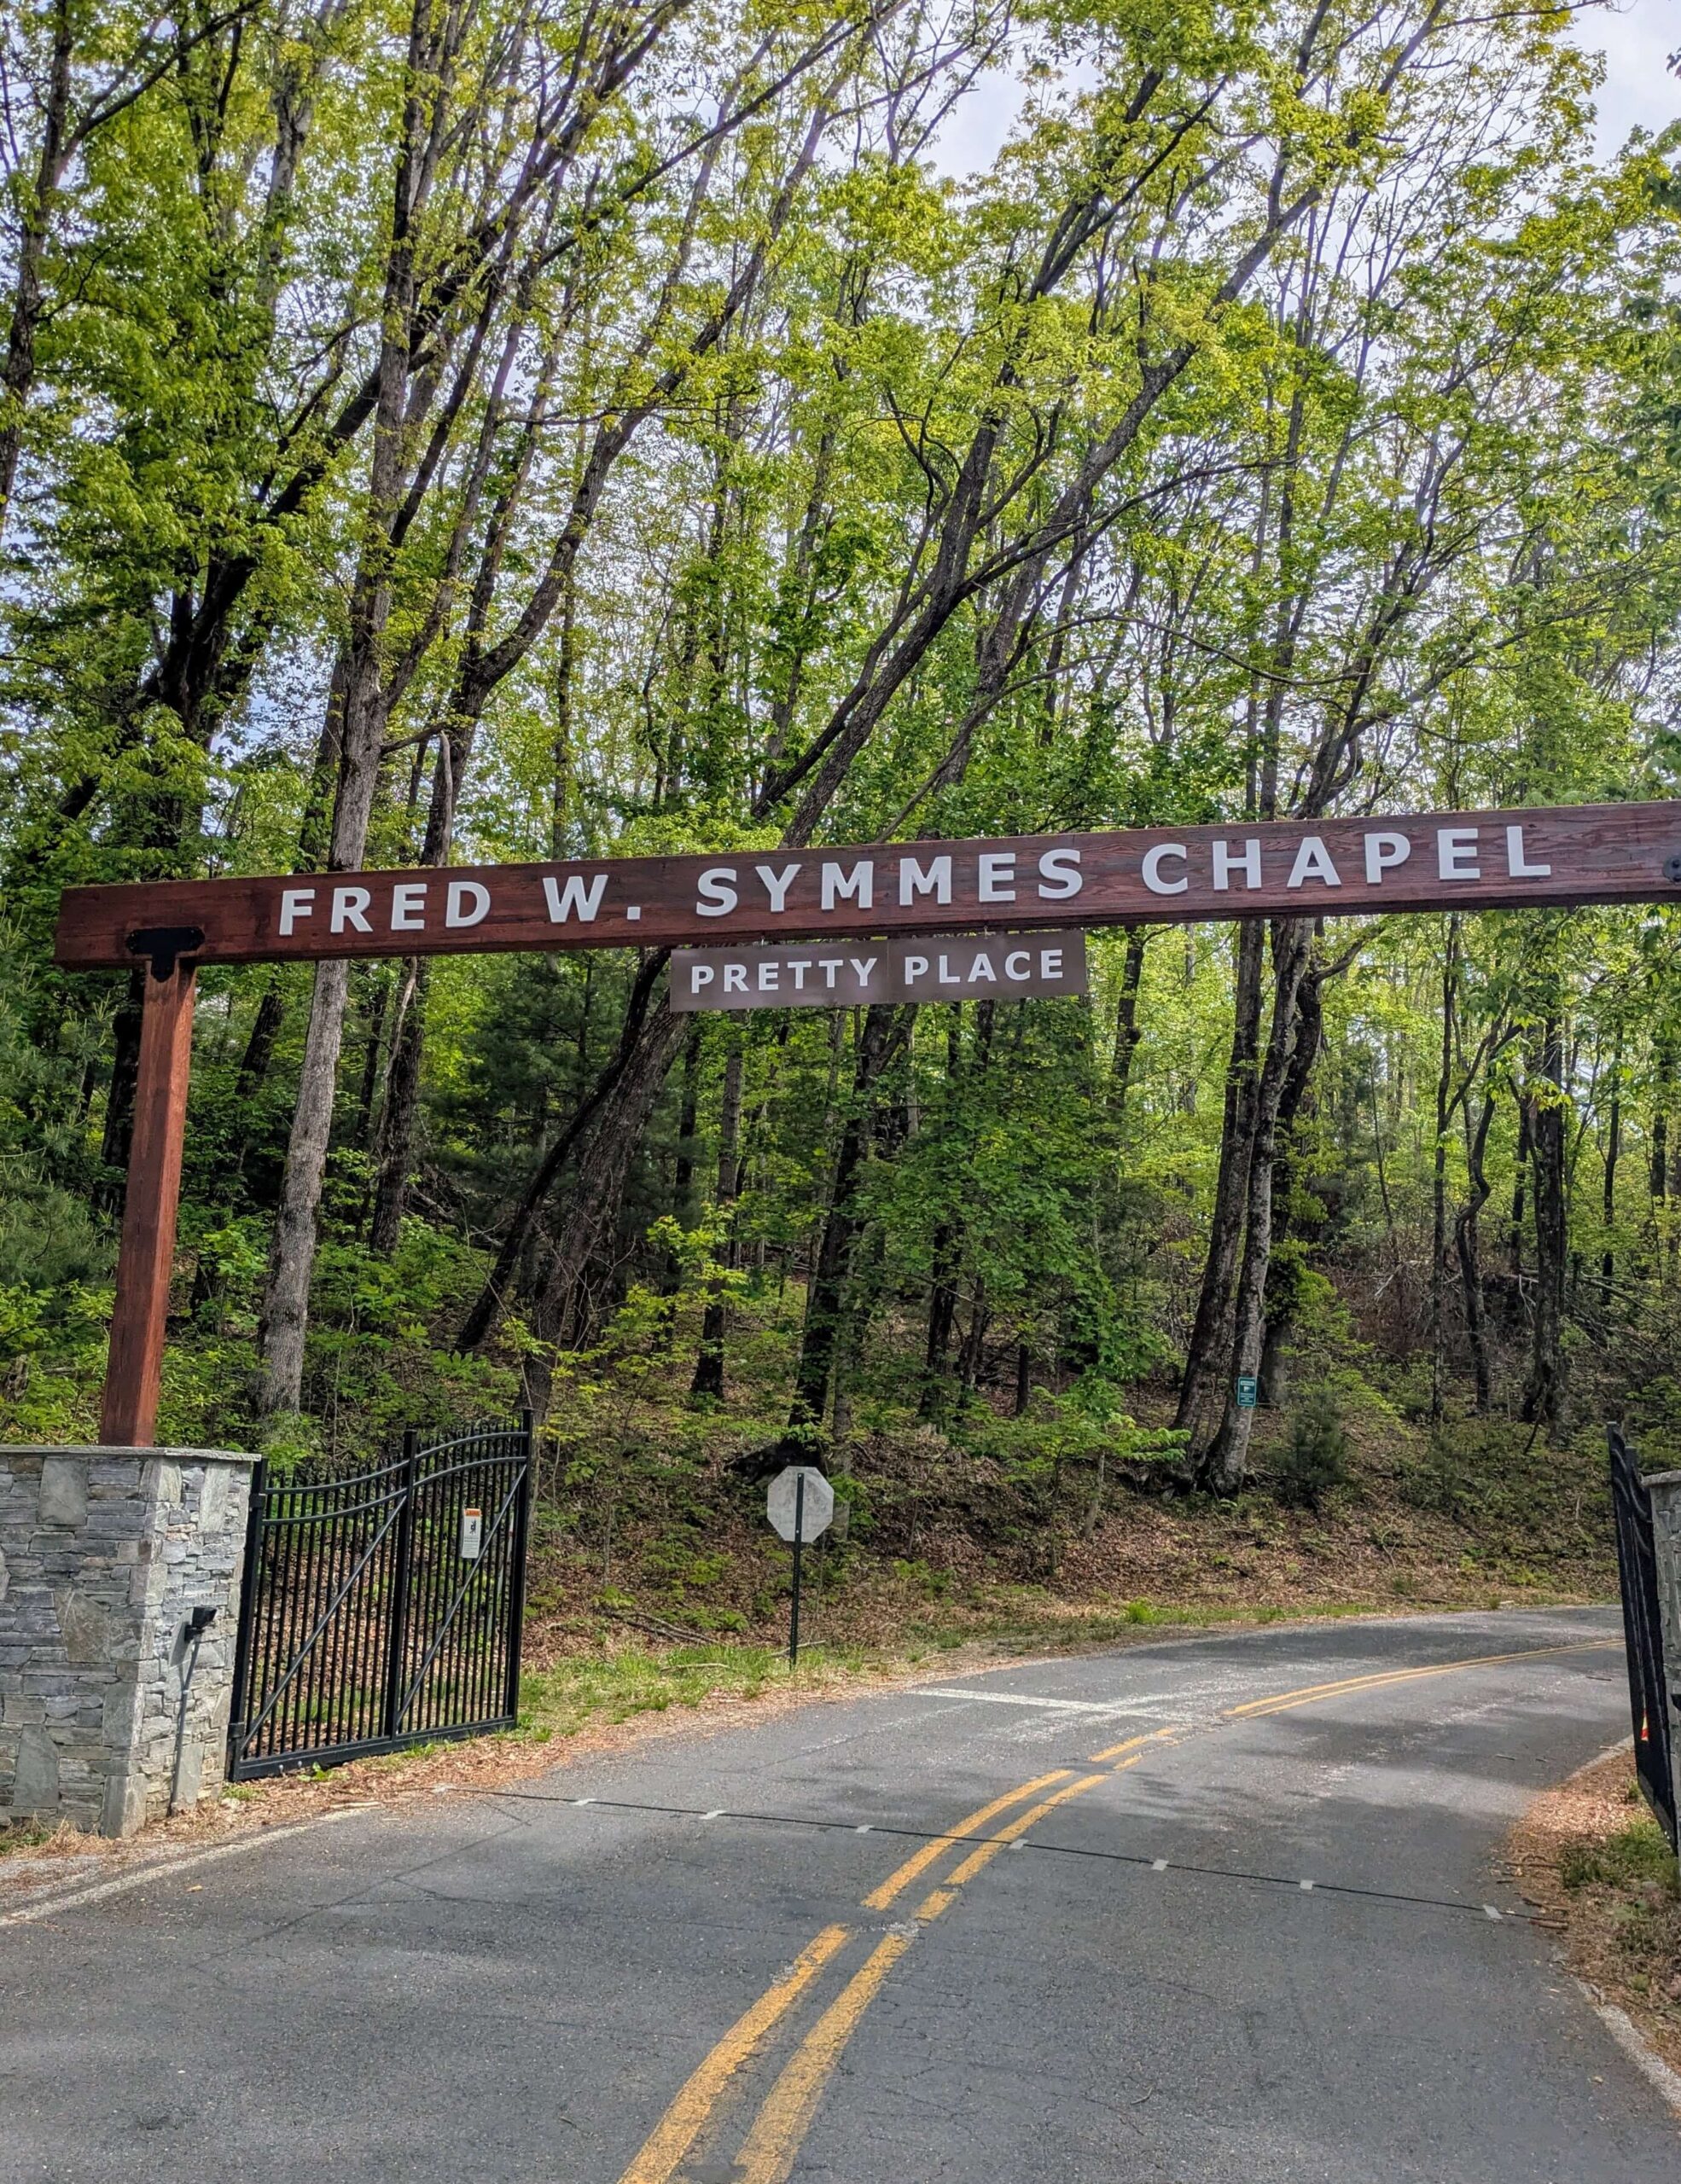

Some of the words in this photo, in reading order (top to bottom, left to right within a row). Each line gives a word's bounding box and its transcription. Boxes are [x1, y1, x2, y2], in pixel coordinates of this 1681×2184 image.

[279, 881, 491, 936] FRED
[543, 874, 641, 923] W.
[696, 849, 1084, 917] SYMMES
[1142, 825, 1552, 895] CHAPEL
[690, 957, 878, 994] PRETTY
[904, 949, 1064, 985] PLACE
